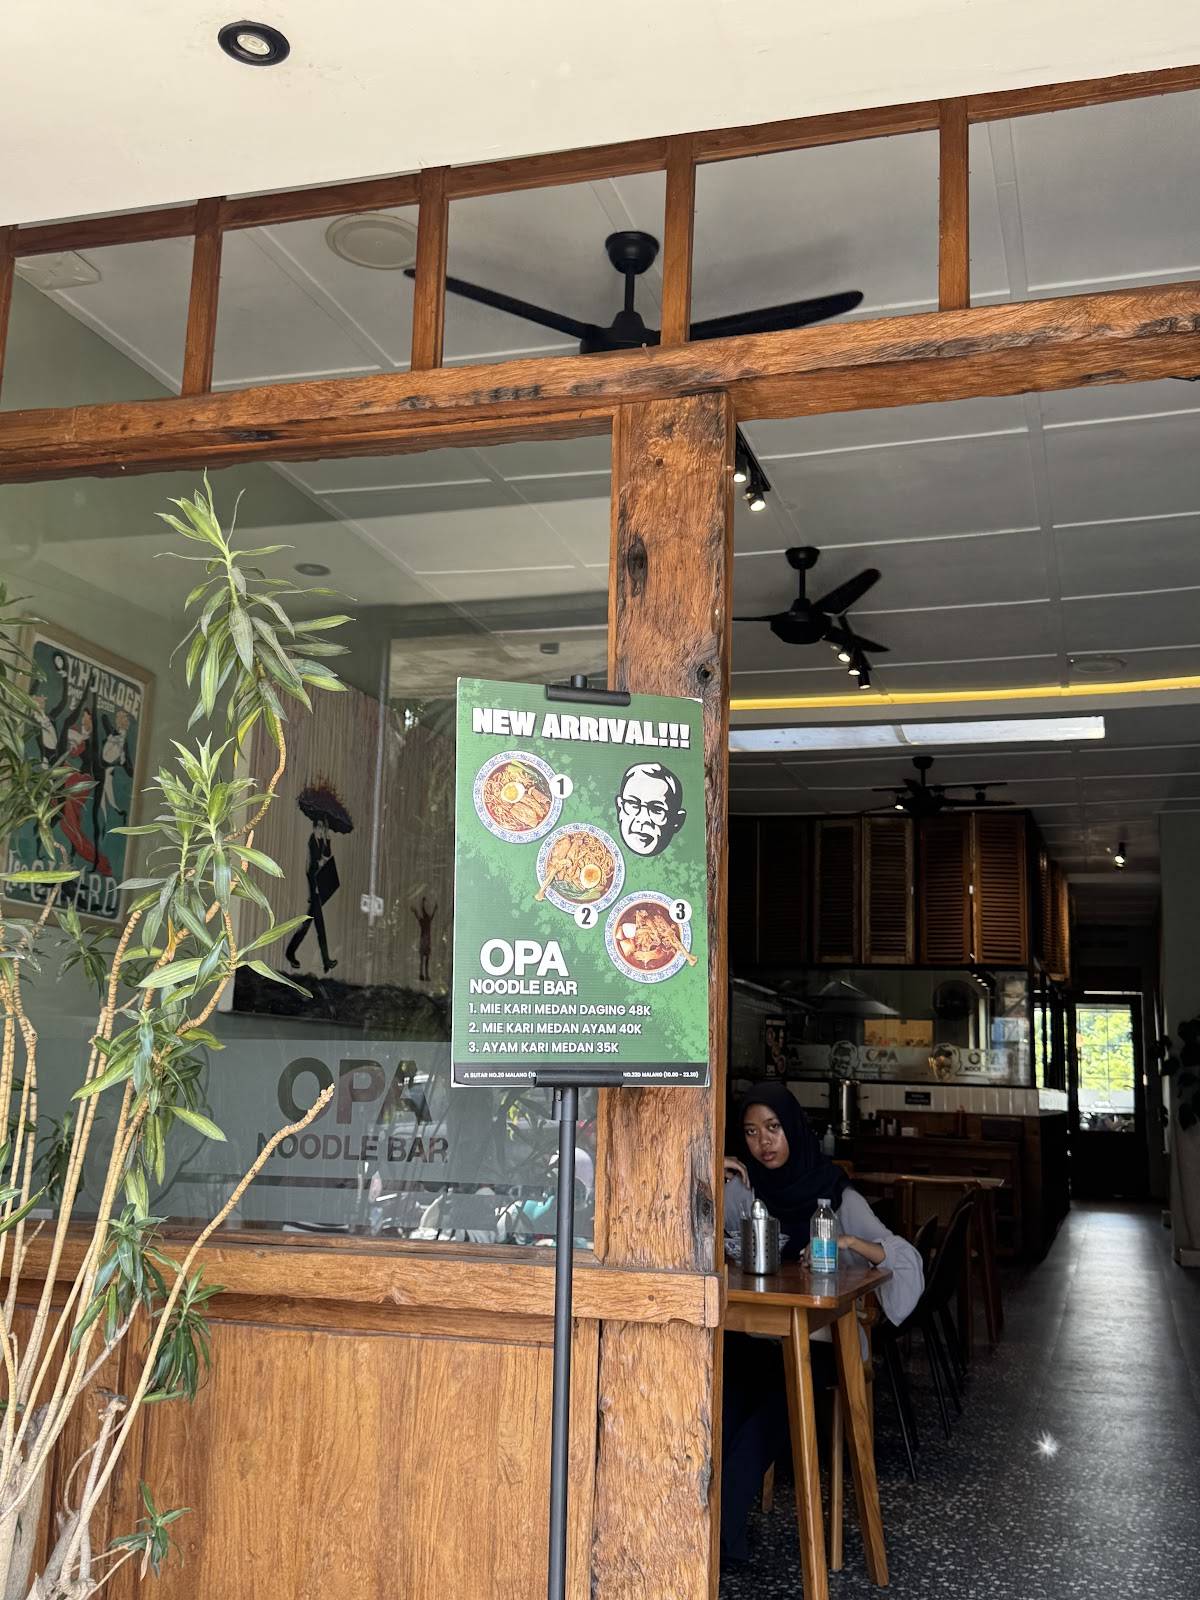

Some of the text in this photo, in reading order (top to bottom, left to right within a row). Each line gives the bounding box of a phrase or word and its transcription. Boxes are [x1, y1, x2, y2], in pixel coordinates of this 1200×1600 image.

[472, 707, 690, 749] NEW ARRIVAL!!!
[556, 778, 565, 795] 1
[581, 907, 591, 925] 2
[675, 902, 686, 920] 3
[479, 938, 569, 977] OPA
[469, 979, 578, 996] NOODLE BAR
[468, 1003, 651, 1016] 1. MIE KARI MEDAN DAGING 48K
[468, 1022, 642, 1035] 2. MIE KARI MEDAN AYAM 40K
[468, 1042, 619, 1053] 3. AYAM KARI MEDAN 35K
[277, 1057, 433, 1125] OPA
[386, 1135, 449, 1164] BAR
